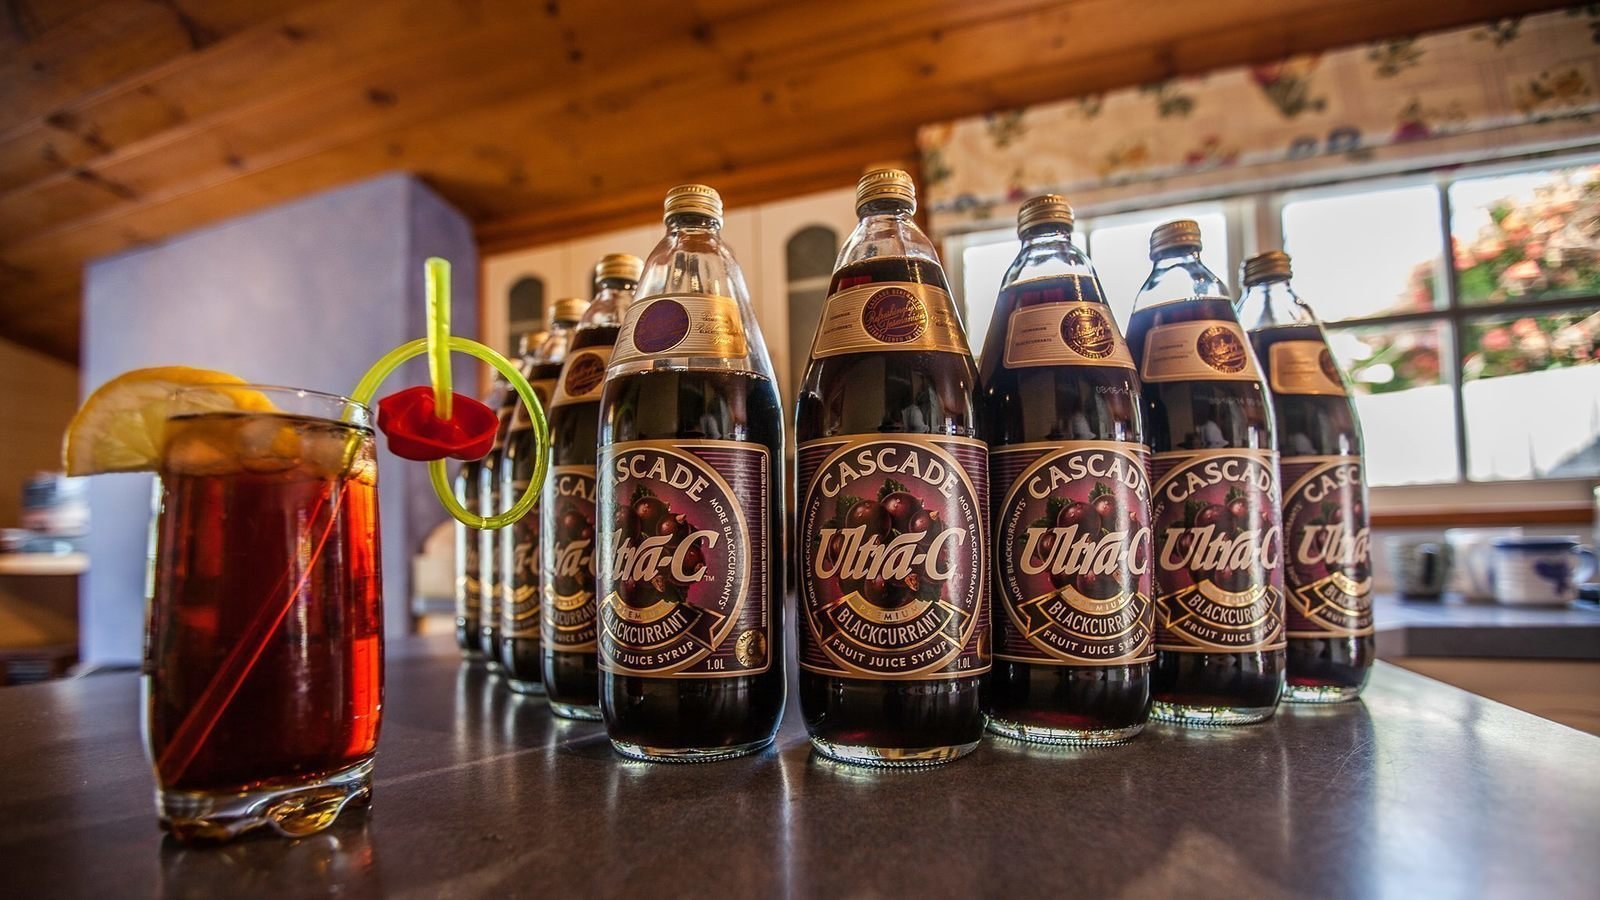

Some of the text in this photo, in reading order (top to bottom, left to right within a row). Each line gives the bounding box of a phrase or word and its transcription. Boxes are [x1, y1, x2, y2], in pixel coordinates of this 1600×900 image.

[611, 454, 710, 503] SCADE
[821, 447, 959, 499] CASCADE
[1028, 454, 1146, 500] CASCADE
[1303, 465, 1359, 503] CASC
[598, 527, 720, 582] ltra-C
[709, 497, 736, 608] MORE BLACKCURRANTS
[814, 524, 967, 581] Ultra-C
[958, 495, 981, 606] MORE BLACKCURRANTS
[1005, 500, 1026, 600] MORE BLACKCURRANTS
[1019, 523, 1150, 575] Ultra-C
[604, 609, 688, 644] BLACKCURRANT
[836, 607, 942, 646] BLACKCURRANT
[1048, 600, 1142, 635] BLACKCURRANT
[1187, 592, 1273, 624] BLACKCURRANT
[1043, 629, 1079, 651] FRUIT
[1081, 642, 1115, 655] JUICE
[1118, 629, 1144, 651] SYRUP
[1183, 618, 1276, 643] FRUIT JUICE SRUP
[623, 654, 653, 665] JUICE
[657, 641, 694, 664] SYRUP
[706, 661, 725, 671] 1.0L
[833, 639, 949, 668] FRUIT JUICE SYRUP
